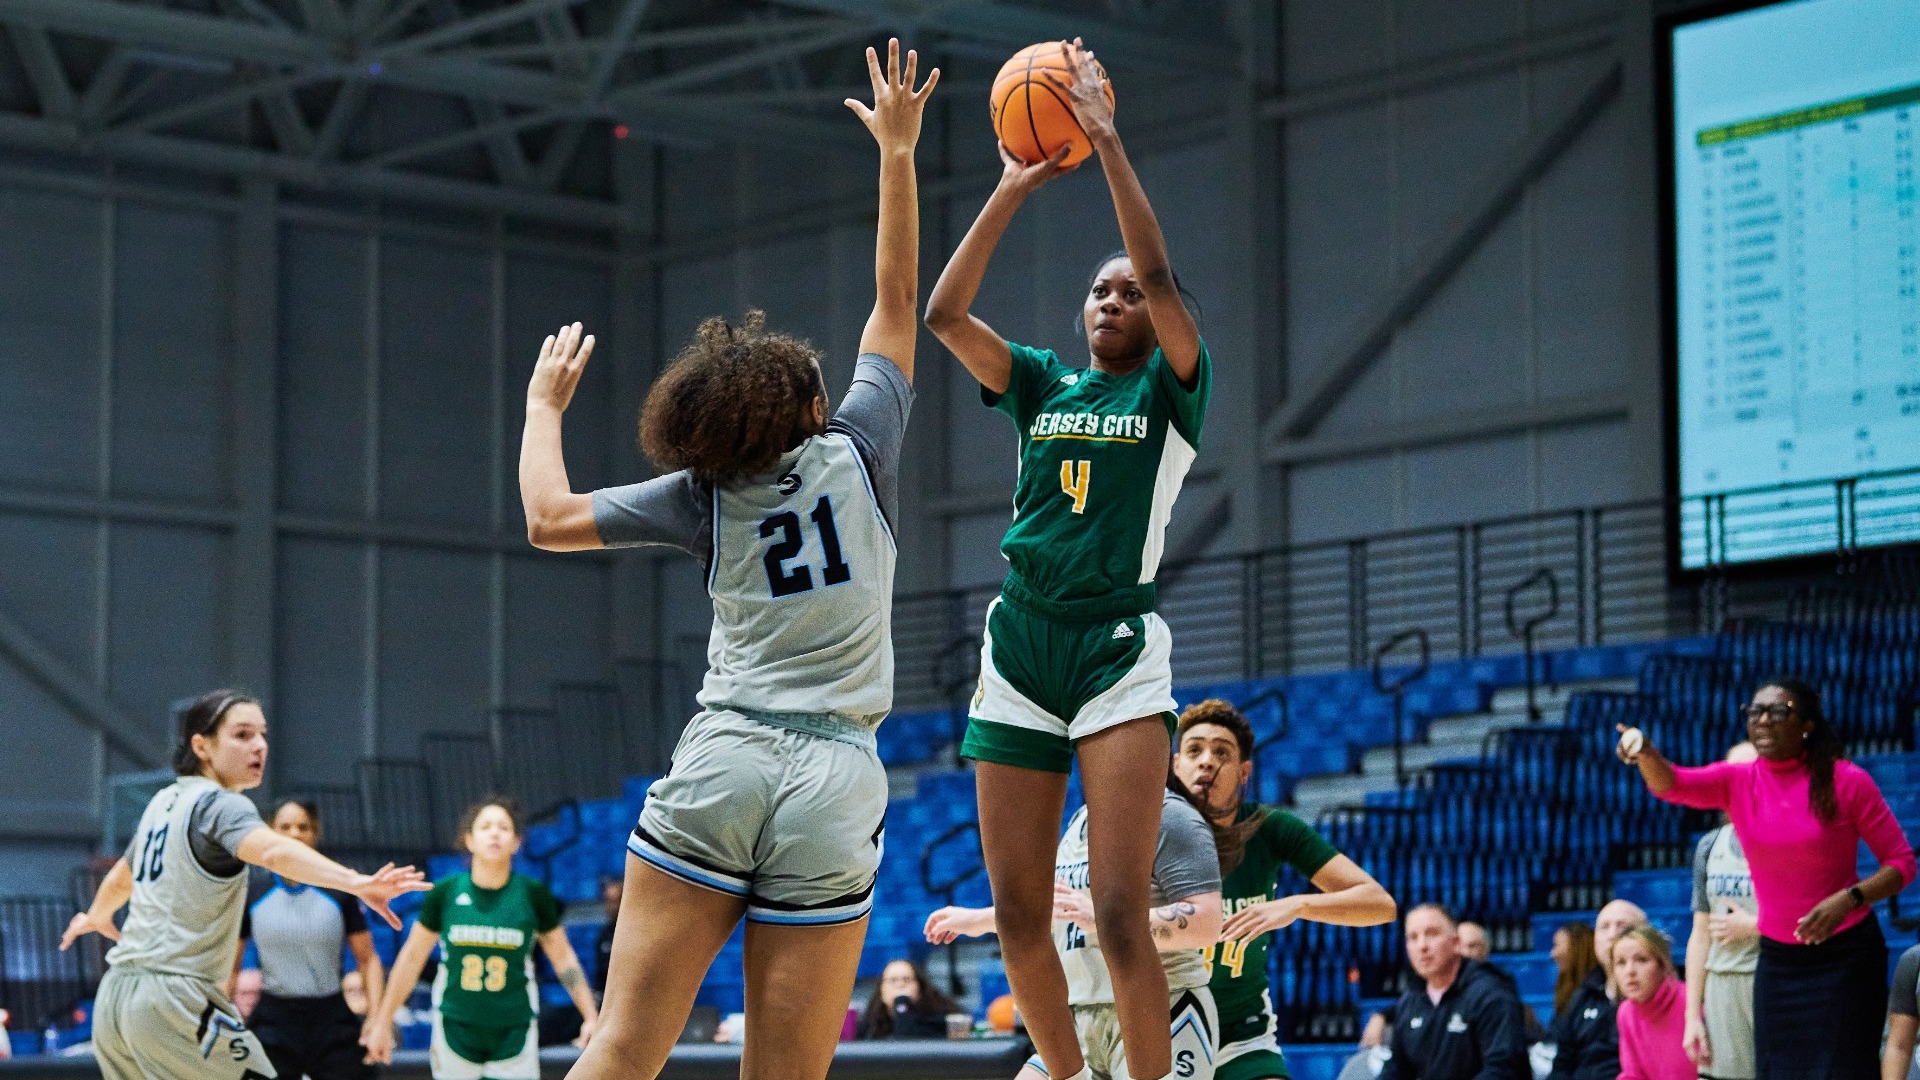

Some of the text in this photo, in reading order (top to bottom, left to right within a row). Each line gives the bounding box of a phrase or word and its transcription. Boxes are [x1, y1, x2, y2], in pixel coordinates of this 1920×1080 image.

[1029, 412, 1148, 439] JERSEY CITY
[1060, 460, 1092, 514] 4
[758, 494, 852, 599] 21
[461, 954, 509, 992] 23
